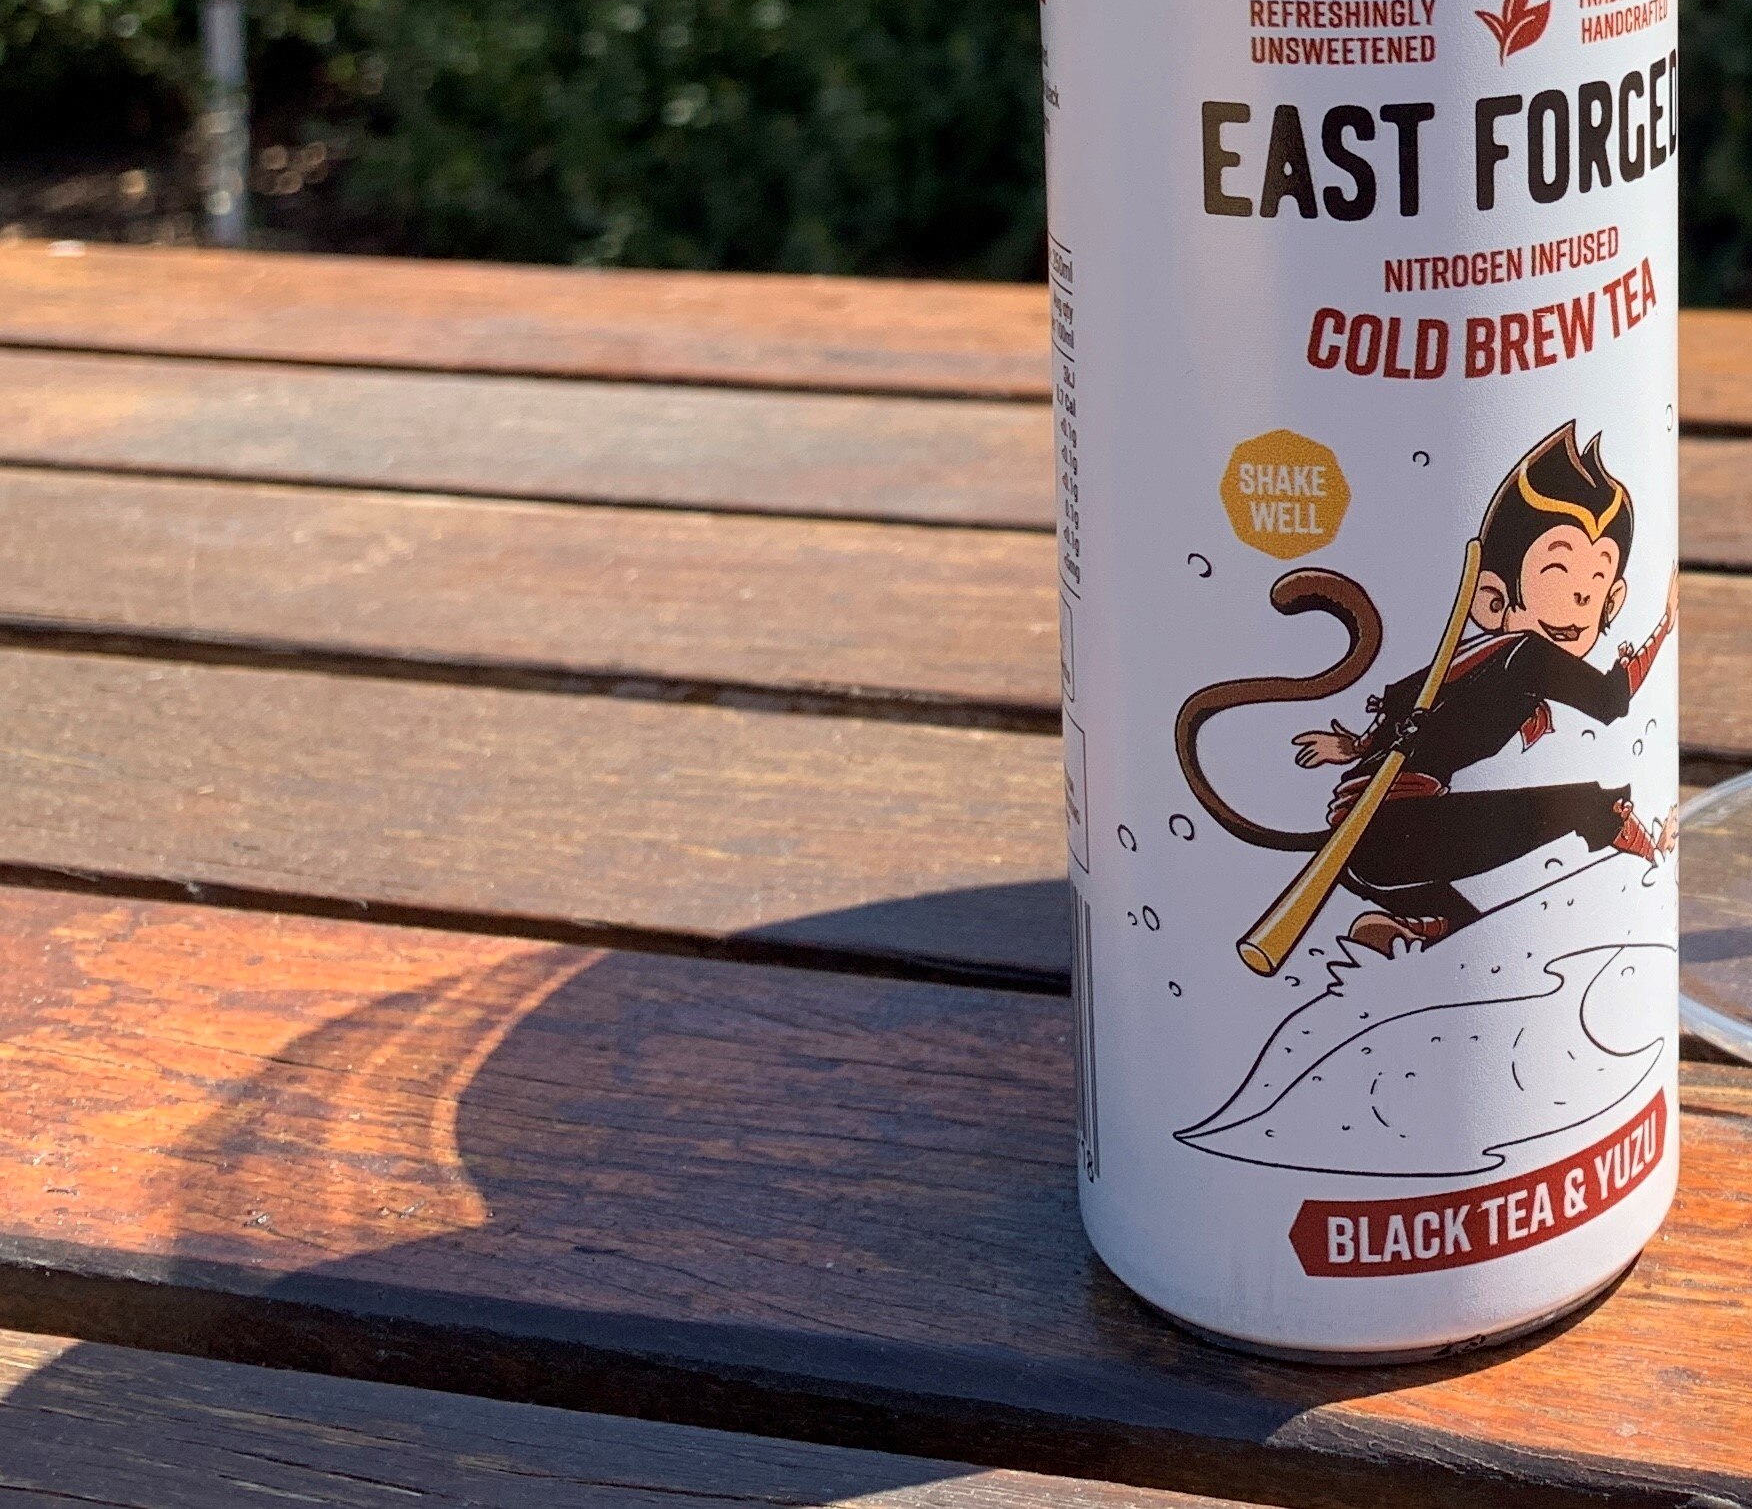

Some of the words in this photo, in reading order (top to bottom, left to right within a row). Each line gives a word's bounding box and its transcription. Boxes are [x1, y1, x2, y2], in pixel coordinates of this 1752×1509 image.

[1251, 36, 1436, 65] UNSWEETENED
[1201, 101, 1435, 221] EAST
[1475, 48, 1678, 211] FORGED
[1384, 247, 1522, 293] NITROGEN
[1531, 226, 1619, 277] INFUSED
[1307, 307, 1449, 380] COLD
[1464, 291, 1596, 379] BREW
[1603, 256, 1657, 339] TEA
[1238, 463, 1328, 497] SHAKE
[1249, 501, 1324, 535] WELL
[1327, 1204, 1472, 1264] BLACK
[1477, 1183, 1555, 1246] TEA
[1563, 1168, 1588, 1218] &
[1594, 1110, 1657, 1200] YUZU
